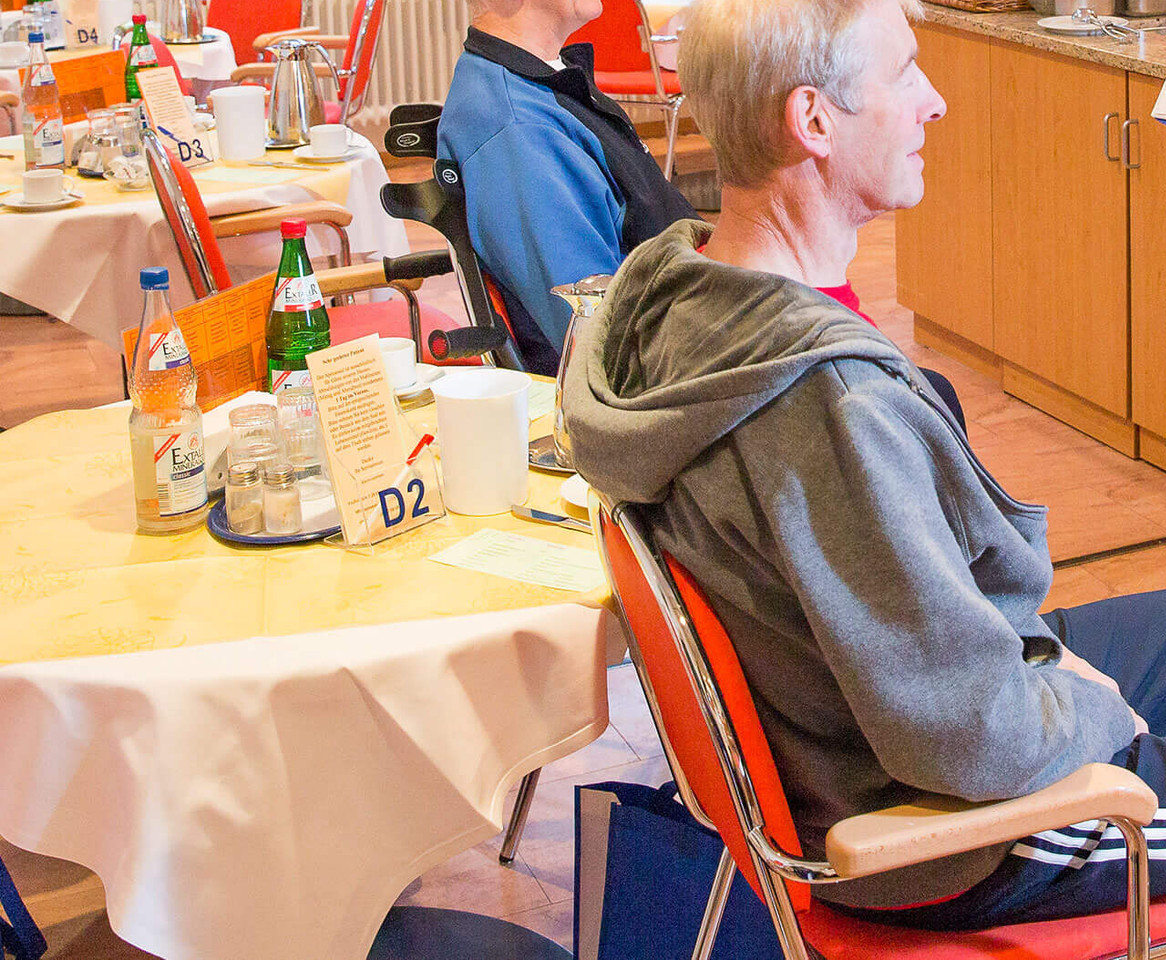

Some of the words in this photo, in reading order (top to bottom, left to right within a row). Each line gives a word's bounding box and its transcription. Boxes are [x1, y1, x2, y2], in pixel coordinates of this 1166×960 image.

[77, 27, 98, 44] D4
[178, 138, 204, 162] D3
[378, 478, 430, 528] D2
